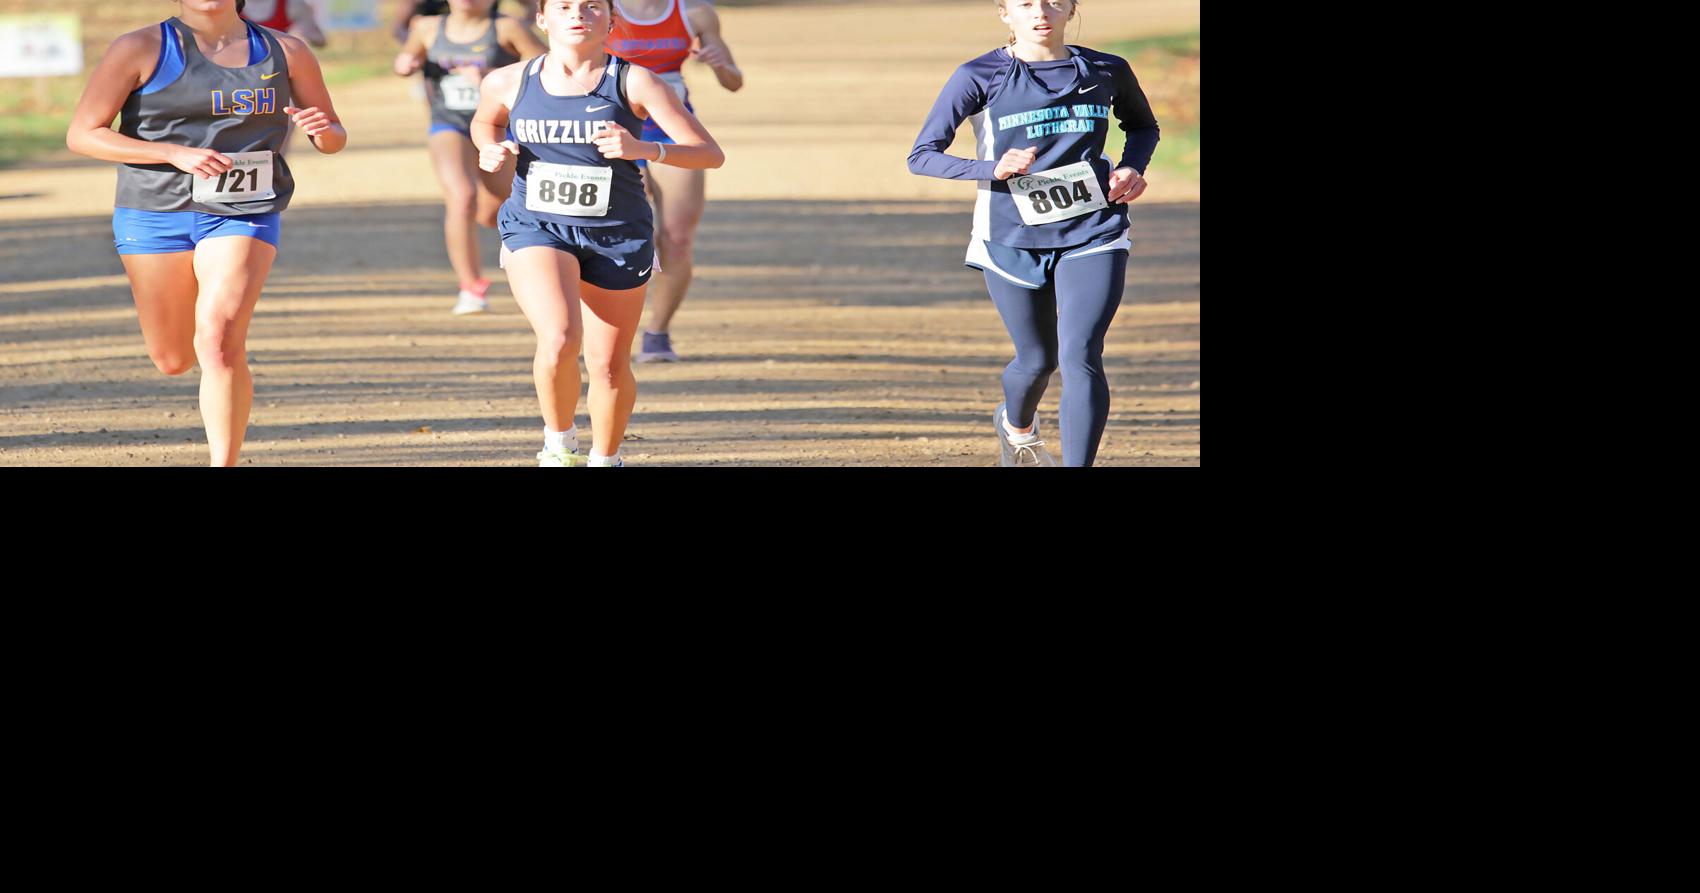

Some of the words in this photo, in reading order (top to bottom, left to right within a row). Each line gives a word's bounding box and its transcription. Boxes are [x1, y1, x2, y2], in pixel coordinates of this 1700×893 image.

[211, 87, 275, 115] LSH
[998, 105, 1069, 131] MINNESOTA
[1072, 104, 1109, 119] VALLE
[1026, 120, 1095, 139] LUTHERAN
[516, 119, 615, 143] GRIZZLIE
[215, 168, 257, 193] 721
[1037, 176, 1061, 186] Pickle
[1063, 169, 1089, 180] Events
[539, 179, 598, 207] 898
[1028, 179, 1092, 214] 804
